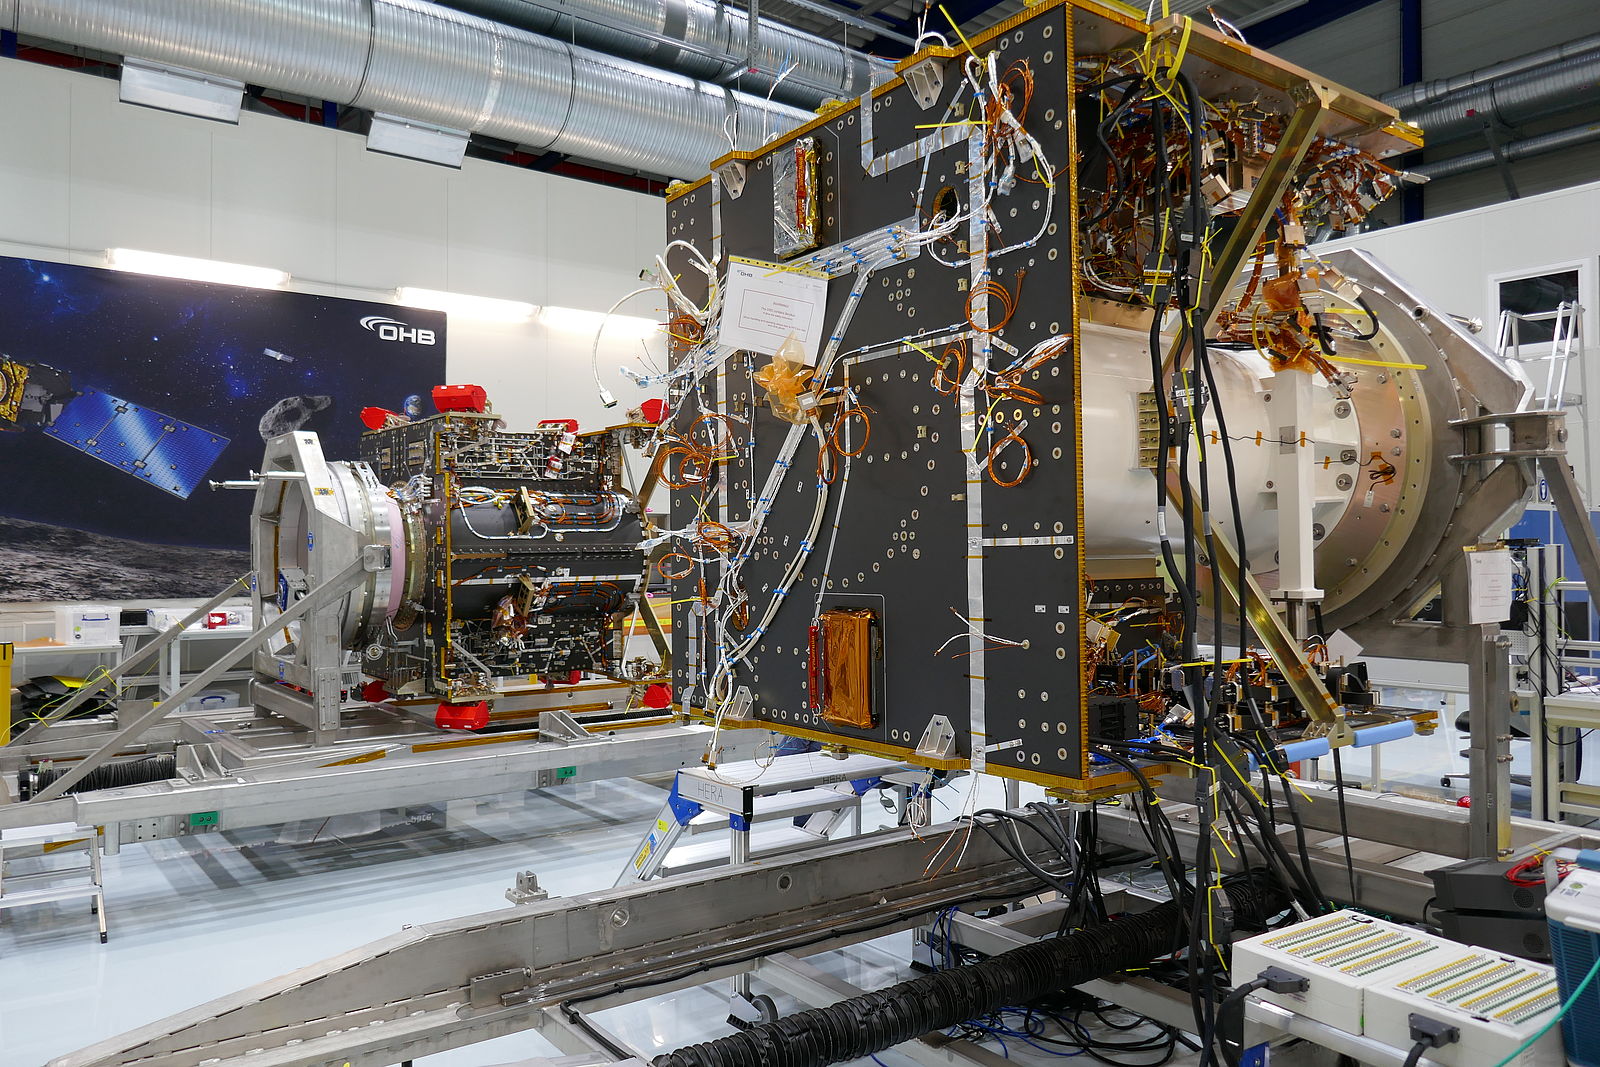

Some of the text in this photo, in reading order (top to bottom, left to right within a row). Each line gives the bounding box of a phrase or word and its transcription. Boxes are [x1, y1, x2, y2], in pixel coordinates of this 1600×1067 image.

[379, 325, 436, 346] OHB
[822, 773, 847, 784] HERA
[697, 781, 724, 804] HERA
